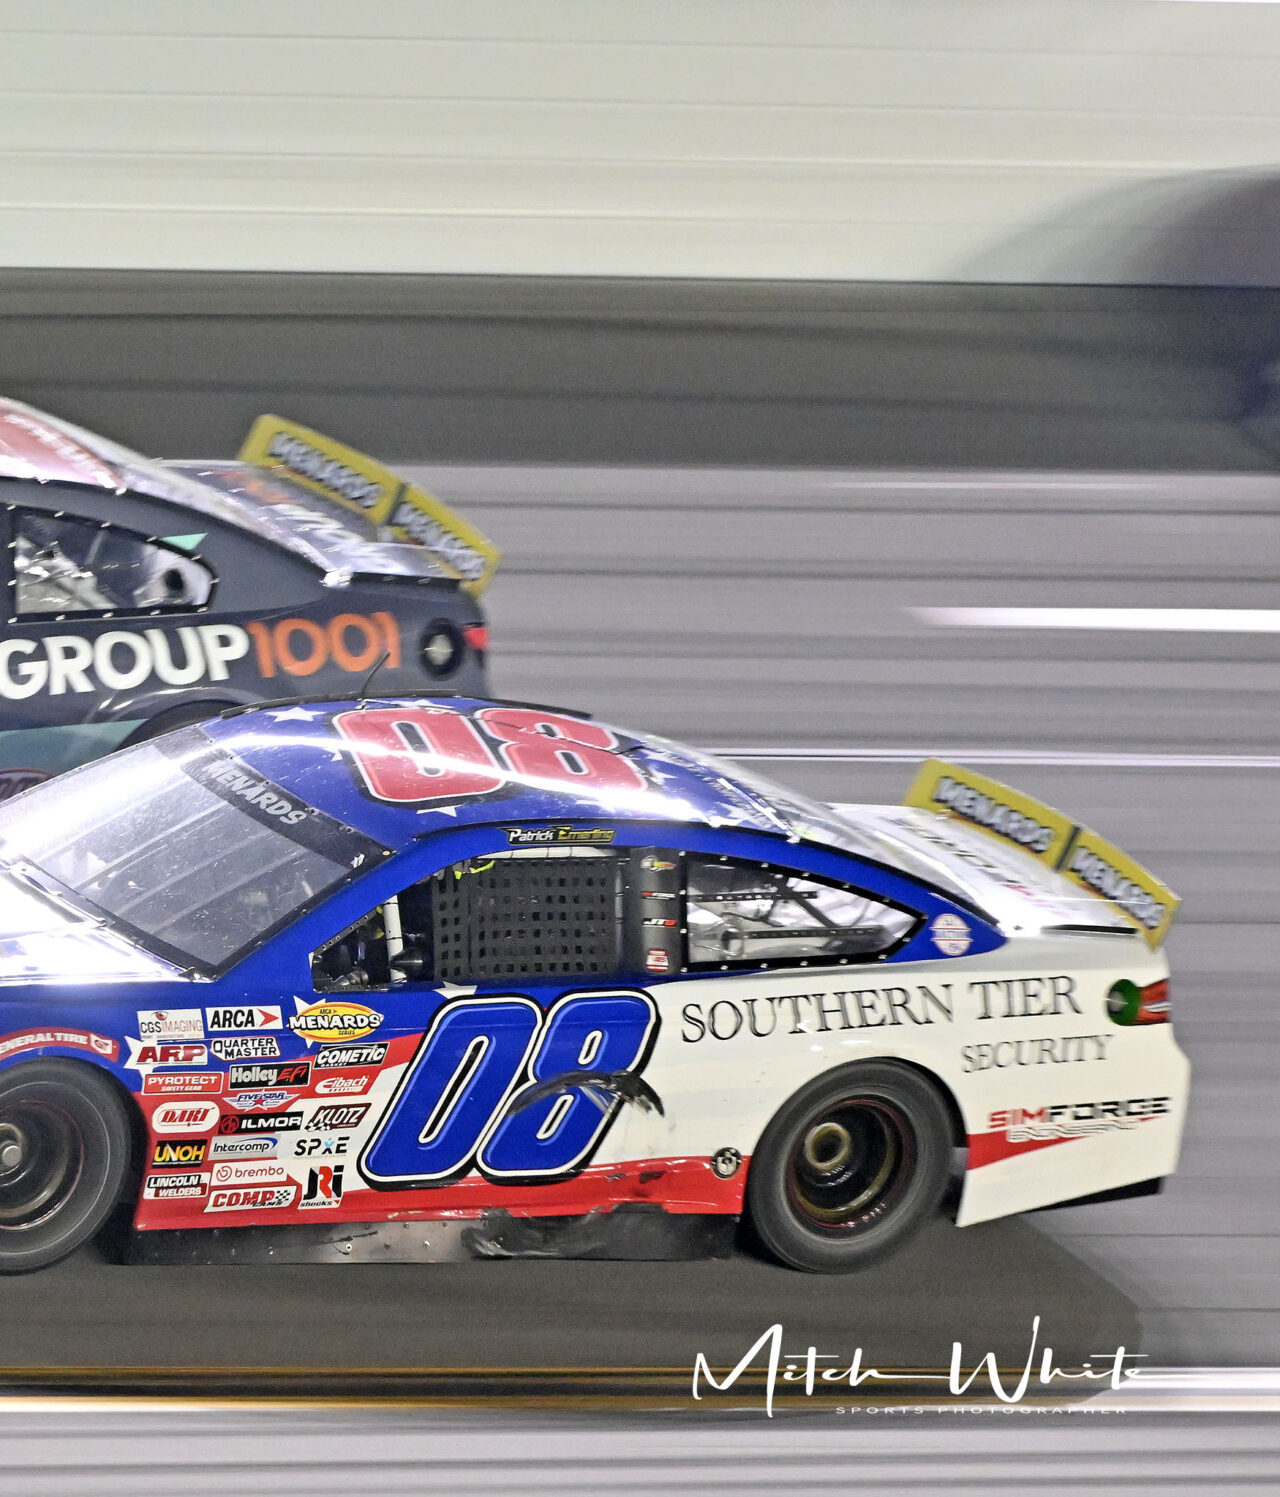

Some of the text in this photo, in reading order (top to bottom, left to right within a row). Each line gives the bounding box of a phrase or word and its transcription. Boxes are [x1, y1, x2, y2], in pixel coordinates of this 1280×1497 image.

[330, 706, 649, 804] 08
[202, 757, 308, 825] MENARDS
[506, 828, 554, 842] Patrick
[681, 975, 1084, 1044] SOUTHERN TIER
[210, 1009, 255, 1028] ARCA
[288, 1014, 381, 1031] MENARDS
[54, 1033, 88, 1045] TIRE
[213, 1038, 274, 1053] QUARTER
[137, 1045, 206, 1063] ARP
[224, 1046, 277, 1060] MASTER
[317, 1047, 386, 1065] COMETIC
[961, 1034, 1114, 1073] SECURITY
[148, 1076, 218, 1085] PYROTECT
[231, 1066, 278, 1085] Holley
[315, 1076, 368, 1094] Eibach
[358, 988, 662, 1191] 08
[237, 1091, 286, 1102] FIVE STAR
[241, 1116, 302, 1129] ILMOR
[316, 1106, 366, 1125] KLOTZ
[154, 1143, 206, 1162] UNOH
[213, 1142, 270, 1153] Intercomp
[235, 1166, 285, 1178] brembo
[150, 1174, 199, 1188] LINCOLN
[159, 1186, 202, 1197] WELDERS
[212, 1190, 276, 1208] COMP
[300, 1200, 333, 1208] shocks
